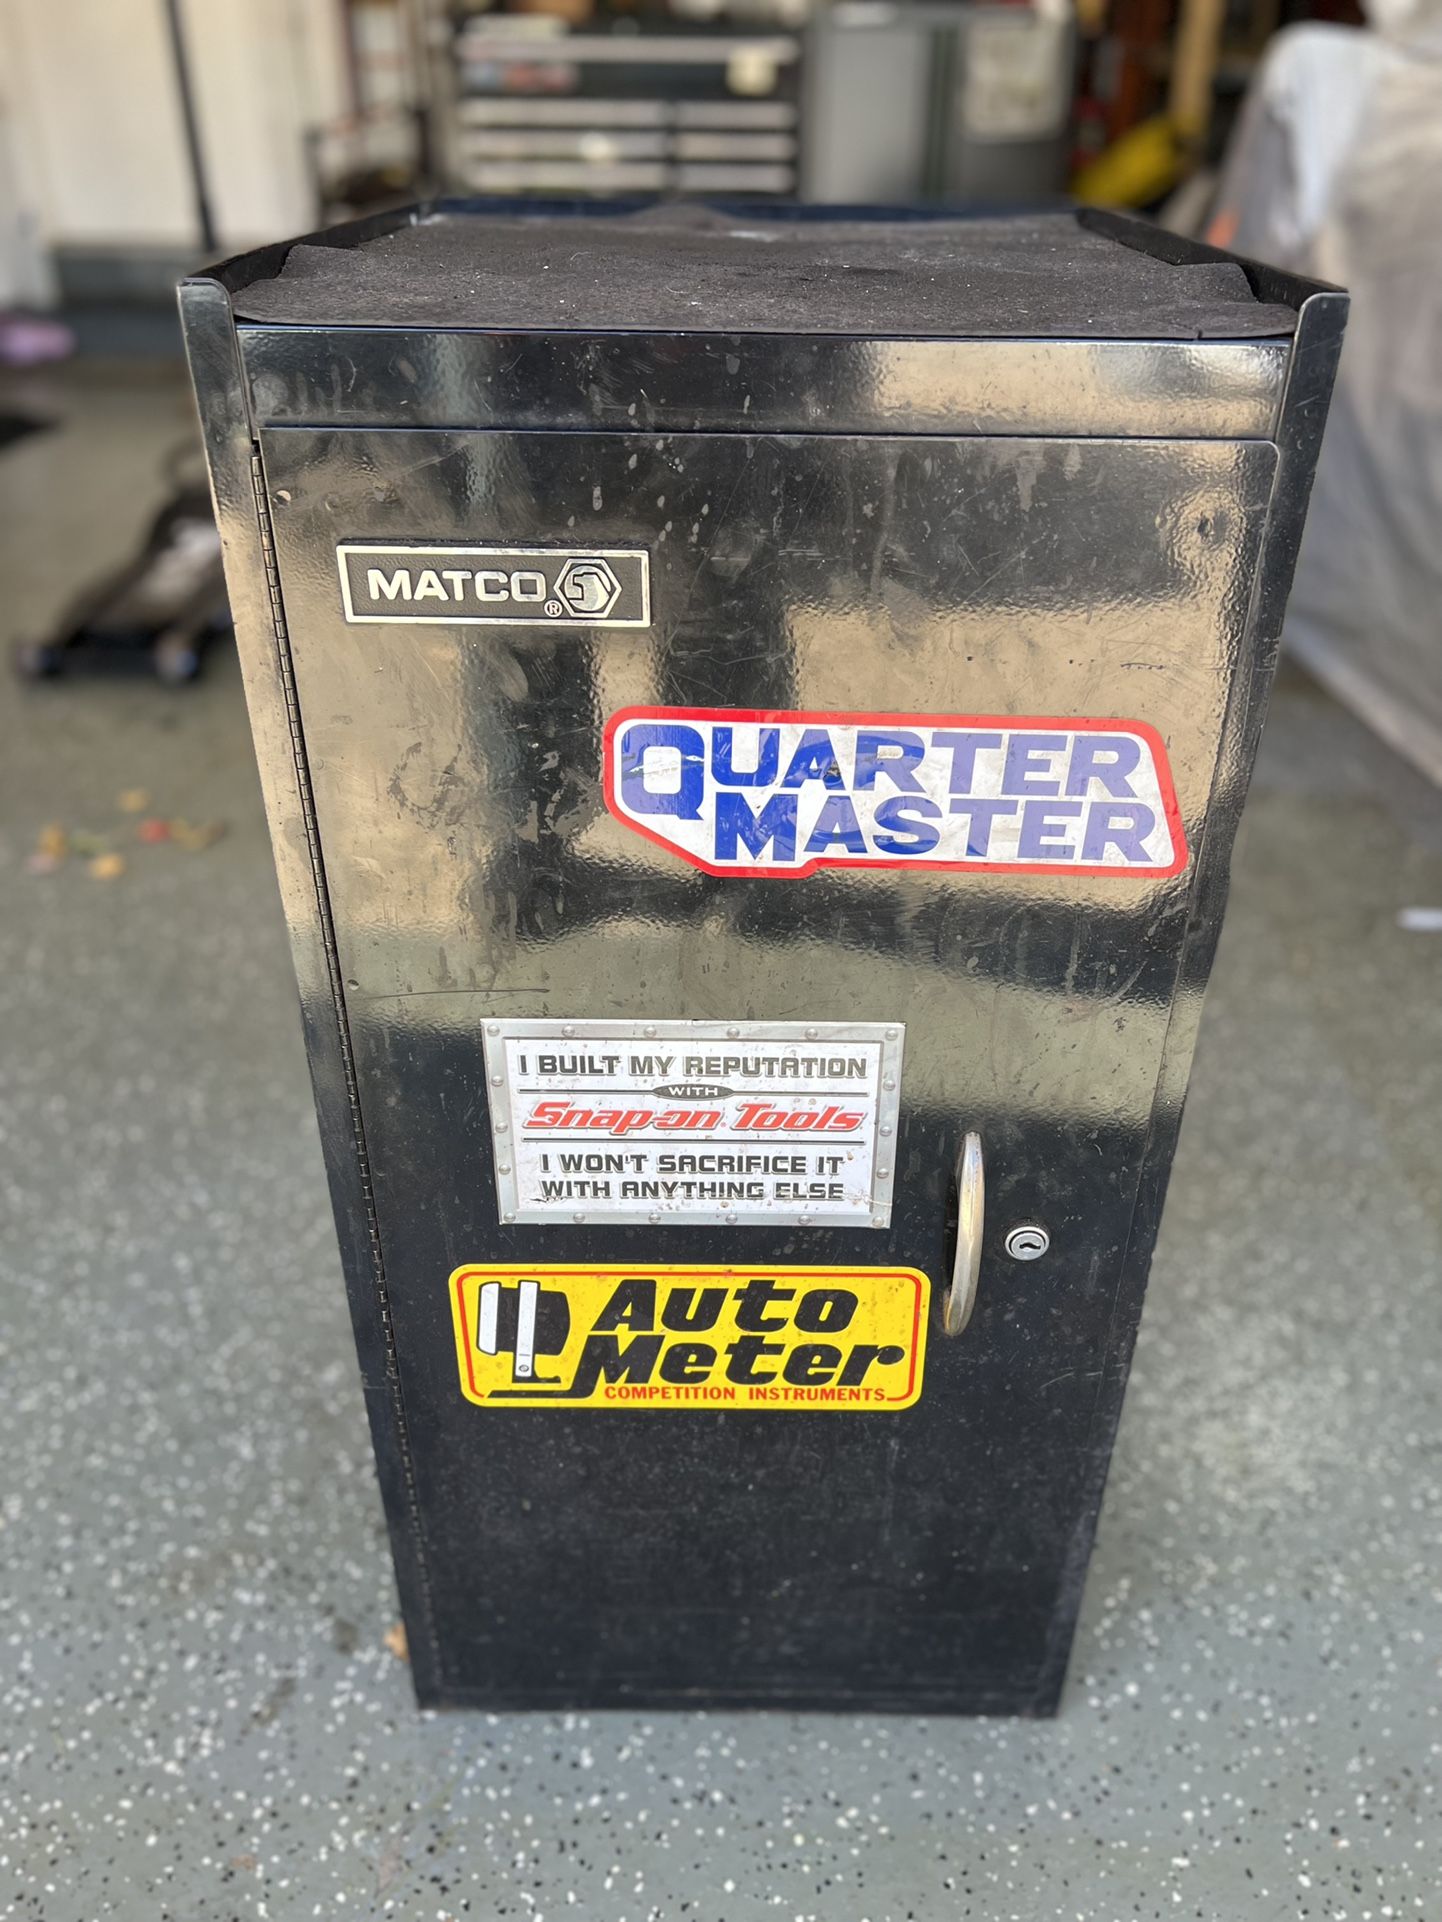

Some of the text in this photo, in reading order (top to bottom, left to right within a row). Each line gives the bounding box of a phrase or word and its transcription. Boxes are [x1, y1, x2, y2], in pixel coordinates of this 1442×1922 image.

[367, 569, 547, 602] MATCO
[620, 723, 1142, 821] QUARTER
[714, 791, 1157, 862] MASTER
[519, 1054, 867, 1078] I BUILT MY REPUTATION
[668, 1086, 719, 1097] WITH
[523, 1101, 865, 1135] Snap-on Tools
[540, 1154, 844, 1175] I WON'T SACRIFICE IT
[541, 1180, 844, 1200] WITH ANYTHING ELSE
[590, 1278, 859, 1333] Auto
[588, 1335, 905, 1386] Meter
[604, 1385, 886, 1402] COMPETITION INSTRUMENTS
